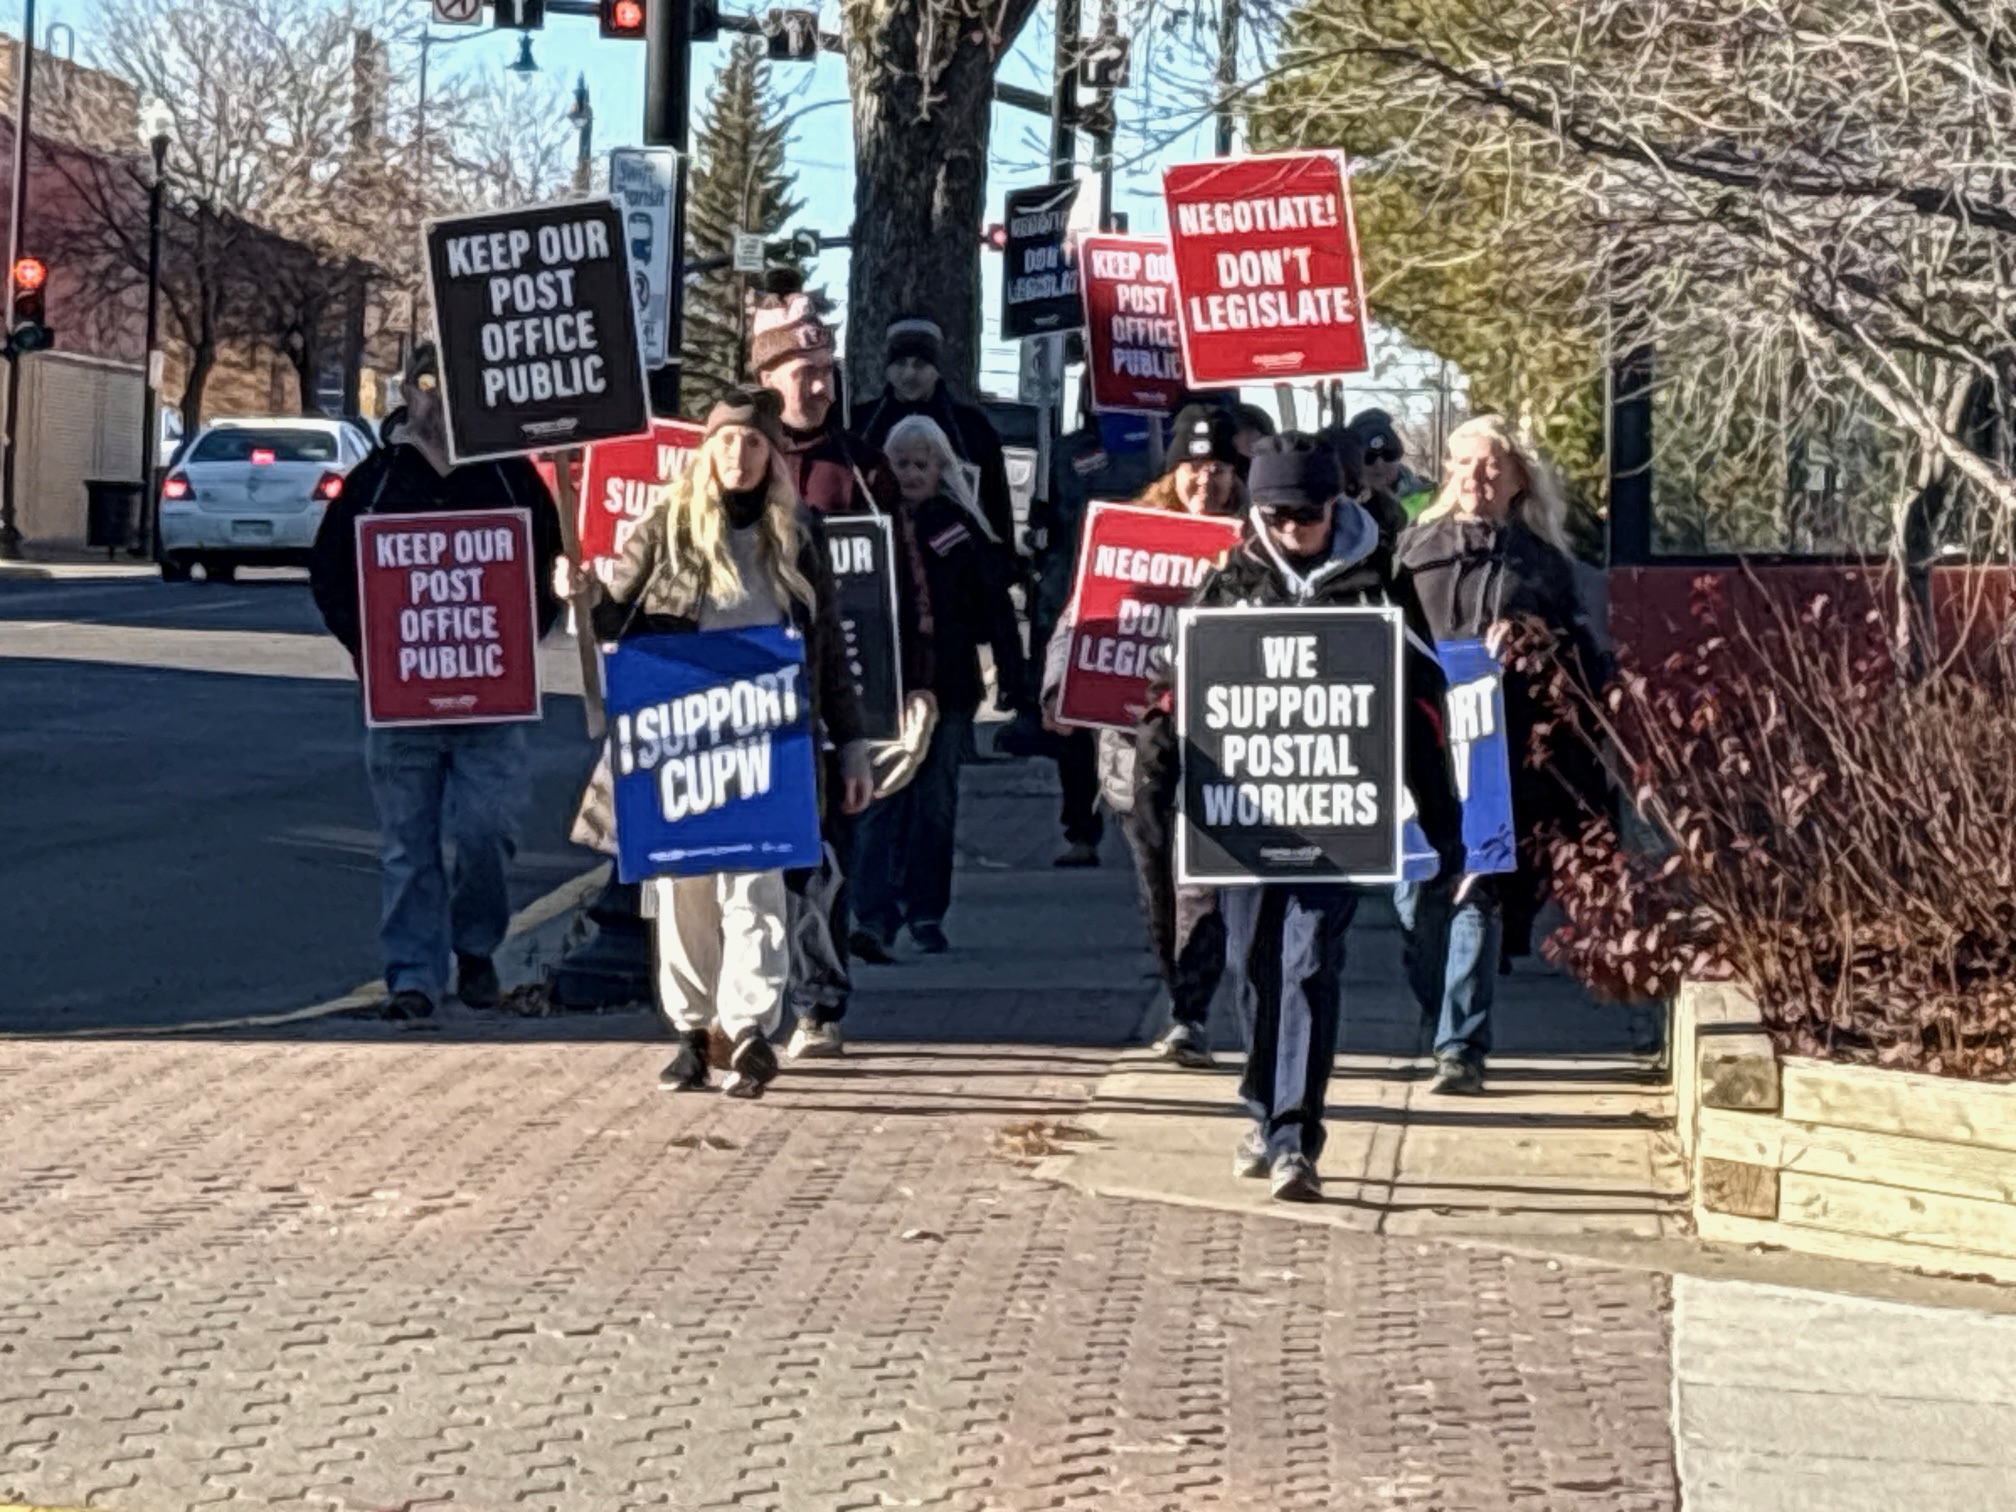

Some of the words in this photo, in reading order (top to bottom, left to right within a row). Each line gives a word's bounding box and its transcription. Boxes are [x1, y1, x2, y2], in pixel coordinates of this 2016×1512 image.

[1178, 193, 1338, 236] NEGOTIATE!
[446, 229, 530, 278] KEEP
[538, 219, 609, 265] OUR
[1092, 249, 1142, 280] KEEP
[1216, 246, 1312, 289] DON'T
[489, 268, 576, 317] POST
[1116, 284, 1168, 315] POST
[1190, 286, 1355, 333] LEGISLATE
[481, 310, 599, 362] OFFICE
[1111, 314, 1179, 347] OFFICE
[482, 353, 607, 408] PUBLIC
[1112, 347, 1182, 381] PUBLIC
[376, 531, 448, 568] KEEP
[454, 527, 514, 564] OUR
[410, 567, 485, 605] POST
[401, 605, 501, 642] OFFICE
[399, 643, 505, 682] PUBLIC
[1262, 636, 1318, 679] WE
[617, 714, 634, 775] I
[636, 663, 800, 769] SUPPORT
[1205, 684, 1376, 729] SUPPORT
[661, 732, 772, 822] CUPW
[1222, 733, 1359, 778] POSTAL
[1203, 782, 1378, 826] WORKERS
